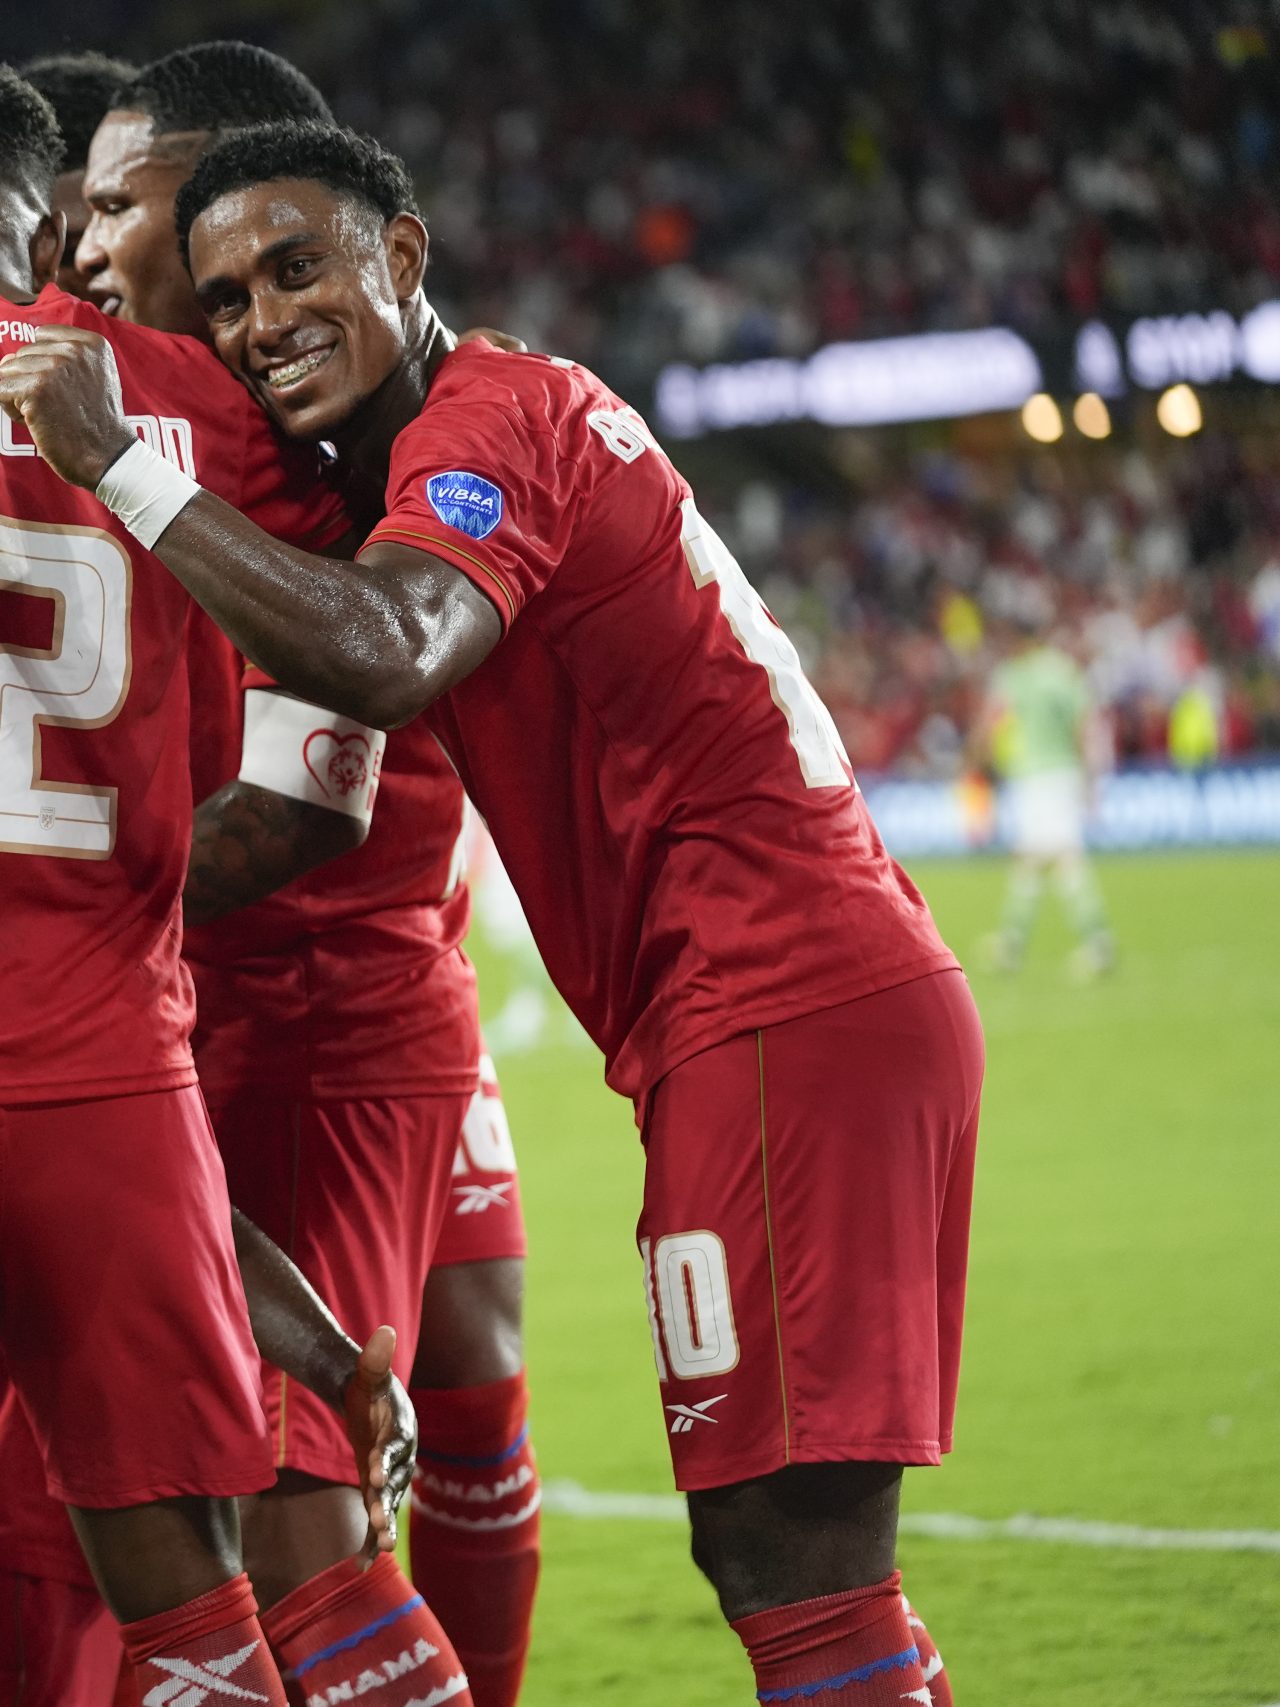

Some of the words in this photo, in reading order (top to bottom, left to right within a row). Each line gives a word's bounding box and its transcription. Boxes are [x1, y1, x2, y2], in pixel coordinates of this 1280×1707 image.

[437, 487, 494, 510] VIBRA
[449, 499, 493, 515] CONTINENTE
[640, 1229, 740, 1382] 10
